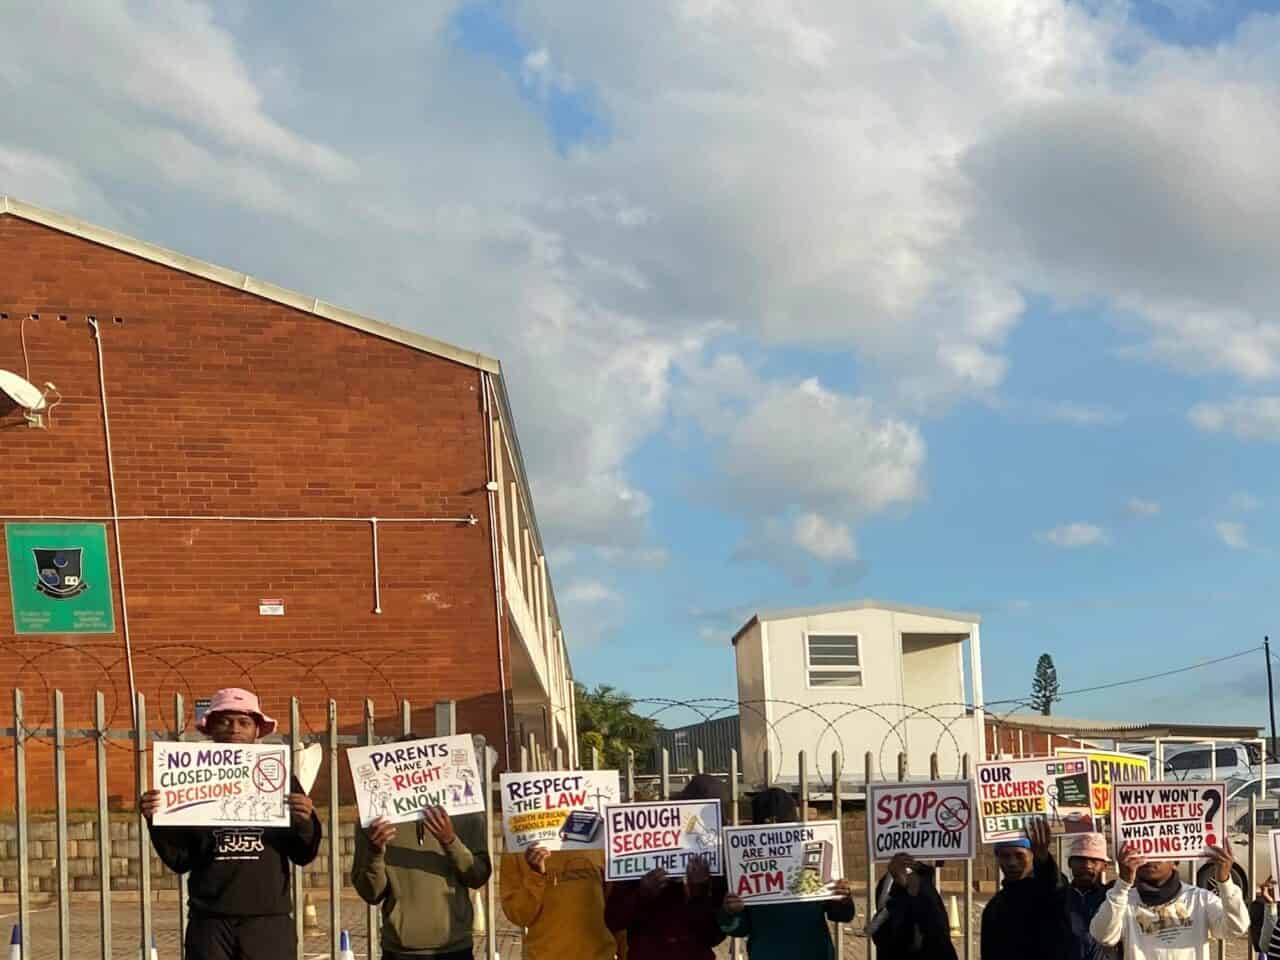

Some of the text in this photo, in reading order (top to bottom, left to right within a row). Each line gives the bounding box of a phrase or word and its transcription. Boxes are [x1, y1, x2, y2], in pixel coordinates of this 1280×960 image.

[167, 749, 243, 769] NO MORE
[369, 743, 449, 771] PARENTS
[160, 766, 250, 788] CLOSED-DOOR
[395, 762, 421, 773] HAVE
[981, 767, 1012, 783] OUR
[1090, 760, 1146, 784] DEMAND
[392, 766, 441, 791] RIGHT
[507, 776, 583, 800] RESPECT
[165, 781, 242, 807] DECISIONS
[412, 785, 427, 794] TO
[981, 780, 1045, 799] TEACHERS
[1119, 789, 1199, 804] WHY WON'T
[393, 789, 447, 814] KNOW!
[513, 790, 587, 812] THE LAW
[877, 791, 938, 825] STOP
[983, 797, 1043, 816] DESERVE
[613, 807, 681, 833] ENOUGH
[1120, 802, 1204, 821] YOU MEET US
[900, 820, 917, 829] THE
[985, 814, 1043, 832] BETT
[1121, 822, 1202, 838] WHAT ARE YOU
[613, 830, 681, 853] SECRECY
[730, 829, 814, 848] OUR CHILDREN
[876, 830, 962, 852] CORRUPTION
[742, 845, 793, 859] ARE NOT
[613, 856, 650, 874] TELL
[652, 853, 677, 869] THE
[740, 860, 778, 873] YOUR
[737, 871, 784, 896] ATM
